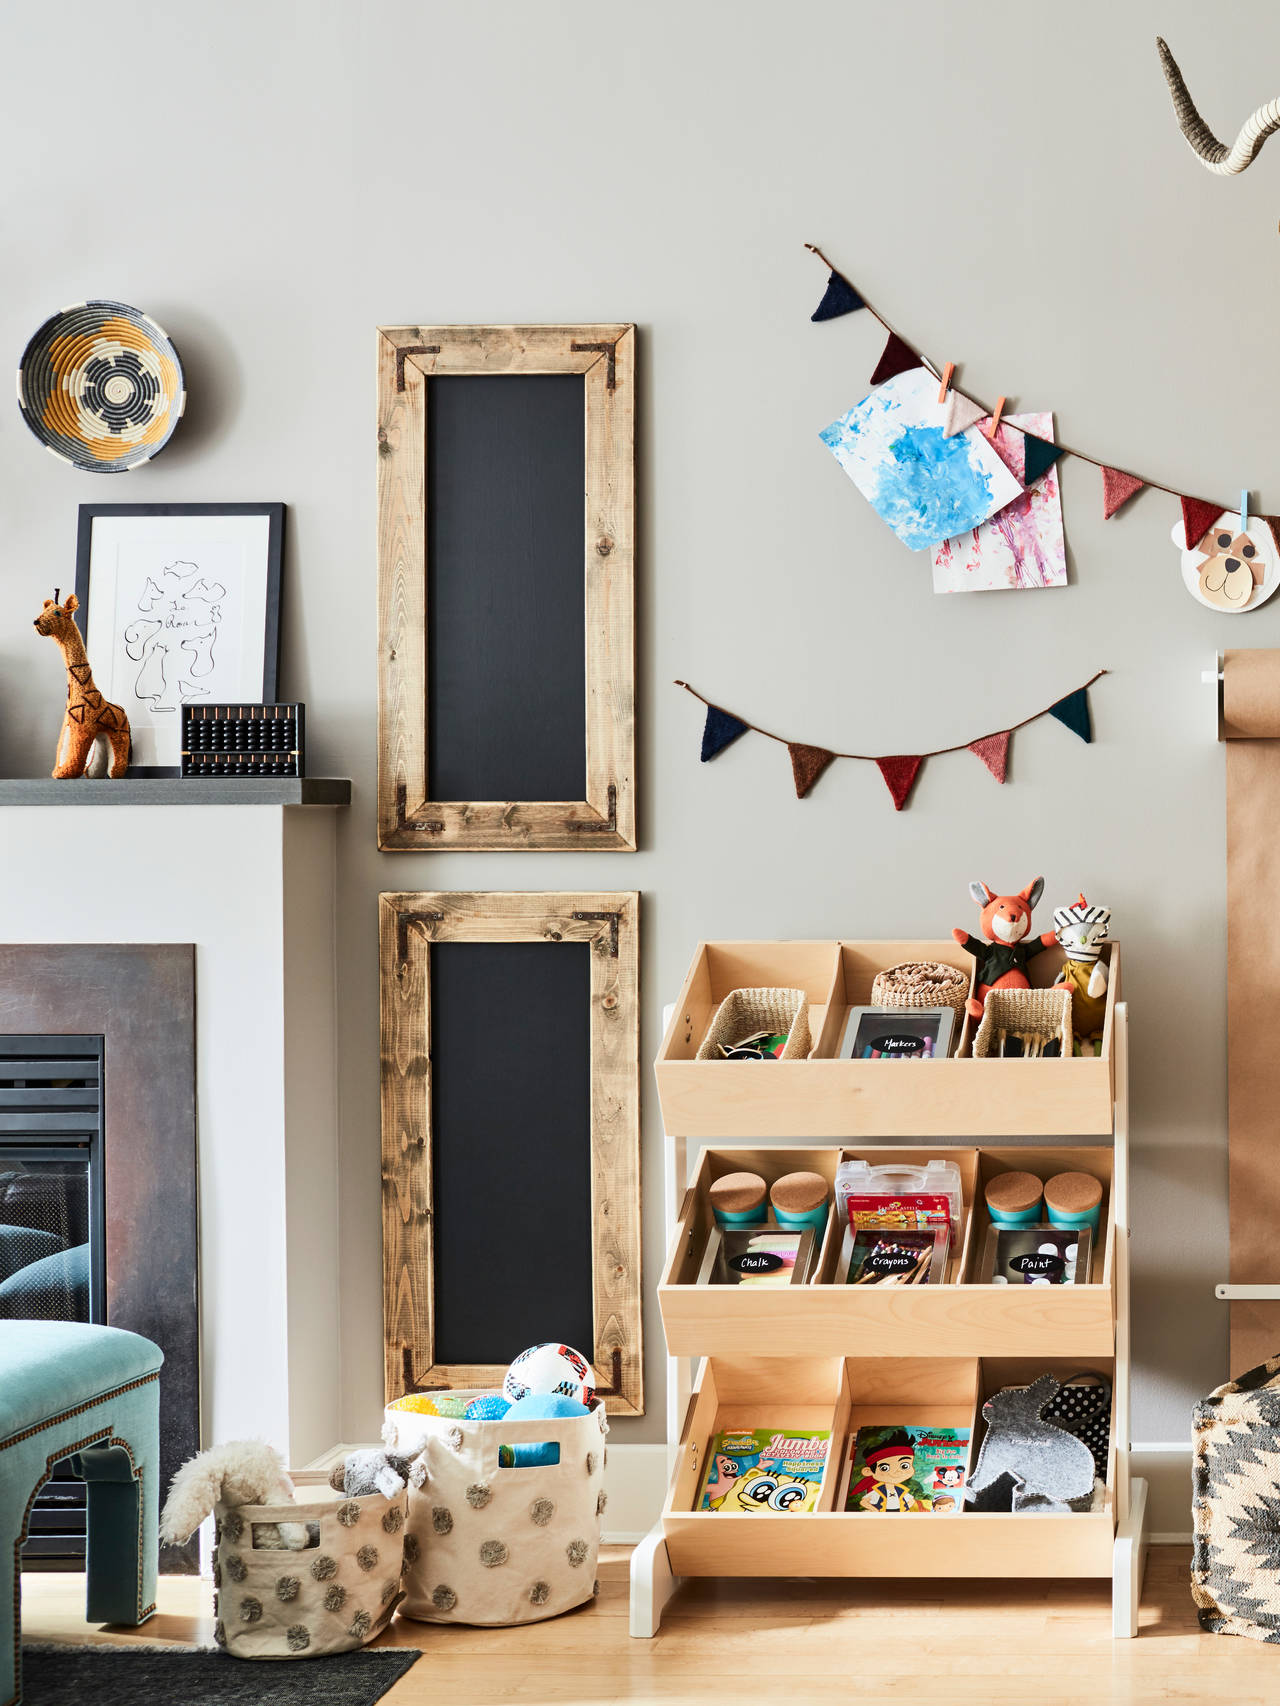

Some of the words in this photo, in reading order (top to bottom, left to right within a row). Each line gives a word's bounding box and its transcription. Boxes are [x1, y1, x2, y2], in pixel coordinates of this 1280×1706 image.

[884, 1038, 917, 1050] Markers
[741, 1258, 769, 1268] Chalk
[872, 1257, 909, 1269] Crayons
[1020, 1256, 1053, 1270] Paint
